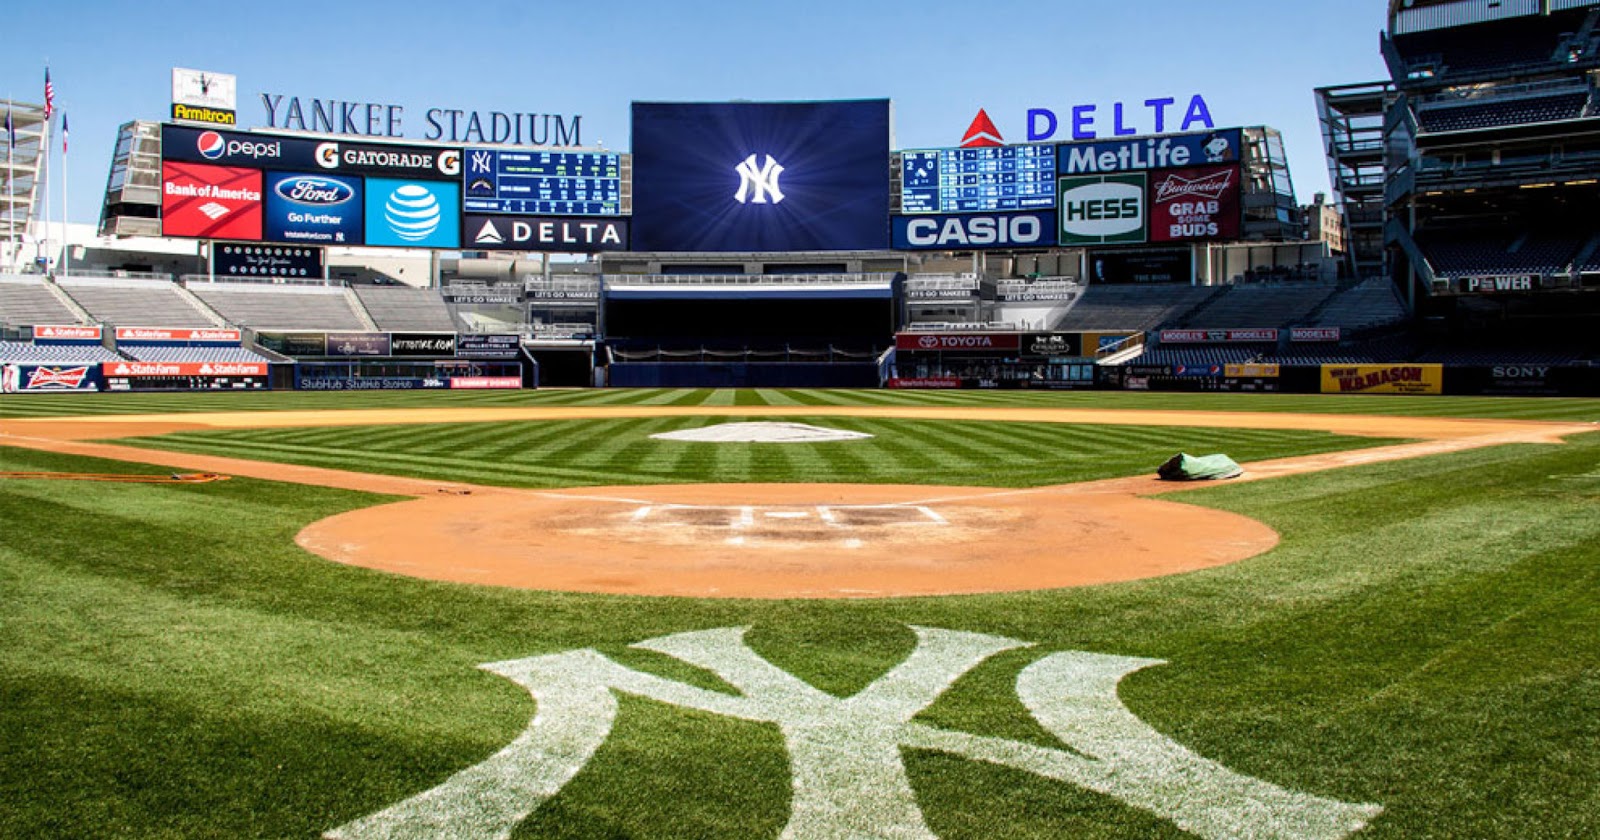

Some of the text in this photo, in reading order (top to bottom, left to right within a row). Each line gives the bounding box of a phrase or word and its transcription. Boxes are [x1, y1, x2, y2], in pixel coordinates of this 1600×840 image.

[175, 104, 235, 124] Armitron
[260, 93, 583, 147] YANKEE STADIUM
[1026, 94, 1214, 142] DELTA
[227, 139, 281, 159] pepsi
[343, 149, 433, 169] GATORADE
[1067, 142, 1191, 174] MetLife
[926, 160, 934, 169] 0
[165, 181, 260, 201] Bank of America
[290, 179, 339, 202] Ford
[1154, 178, 1230, 196] Budweiser
[287, 212, 342, 225] Go Further
[1068, 198, 1138, 222] HESS
[1169, 201, 1220, 216] GRAB
[1177, 214, 1211, 224] SOME
[511, 221, 621, 244] DELTA
[906, 215, 1041, 246] CASIO
[1169, 222, 1219, 238] BUDS
[940, 336, 992, 347] TOYOTA
[1492, 367, 1549, 378] SONY
